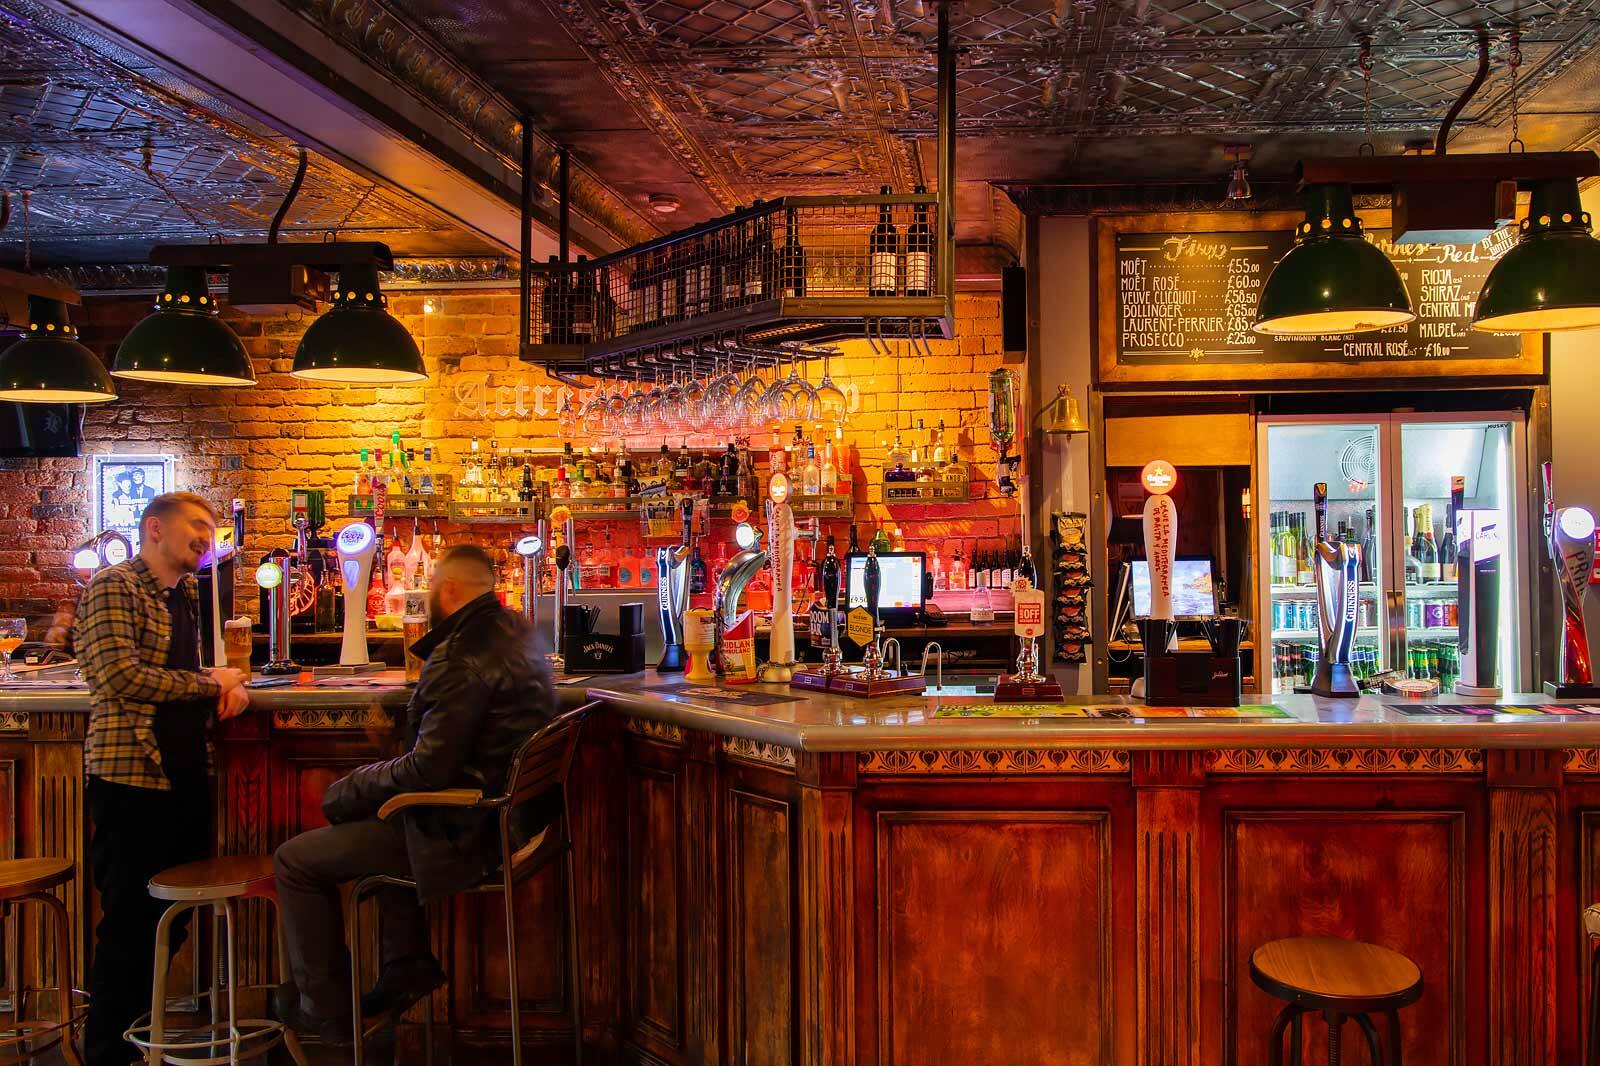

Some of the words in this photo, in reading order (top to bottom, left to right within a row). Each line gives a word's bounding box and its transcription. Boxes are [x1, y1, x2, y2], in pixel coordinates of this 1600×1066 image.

[1437, 243, 1479, 263] Red
[1228, 258, 1260, 273] £55.00
[1153, 273, 1180, 291] ROSÉ
[1227, 275, 1260, 289] £60.00
[1421, 269, 1452, 285] RIOJA
[1121, 291, 1151, 305] VEUVE
[1154, 290, 1197, 305] CLICQUOT
[1420, 285, 1461, 302] SHIRAZ
[1123, 305, 1183, 318] BOLLINGER
[1418, 302, 1462, 318] CENTRAL
[1123, 317, 1225, 332] LAURENT-PERRIER
[1419, 322, 1457, 338] MALBEC
[1122, 332, 1184, 348] PROSECCO
[1226, 332, 1256, 345] £25.00
[1343, 342, 1384, 357] CENTRAL
[1385, 339, 1409, 357] ROSÉ
[1487, 422, 1510, 430] HUSKY
[1346, 580, 1356, 622] GUINNESS
[1023, 609, 1040, 619] OFF
[849, 624, 872, 635] BLONDE
